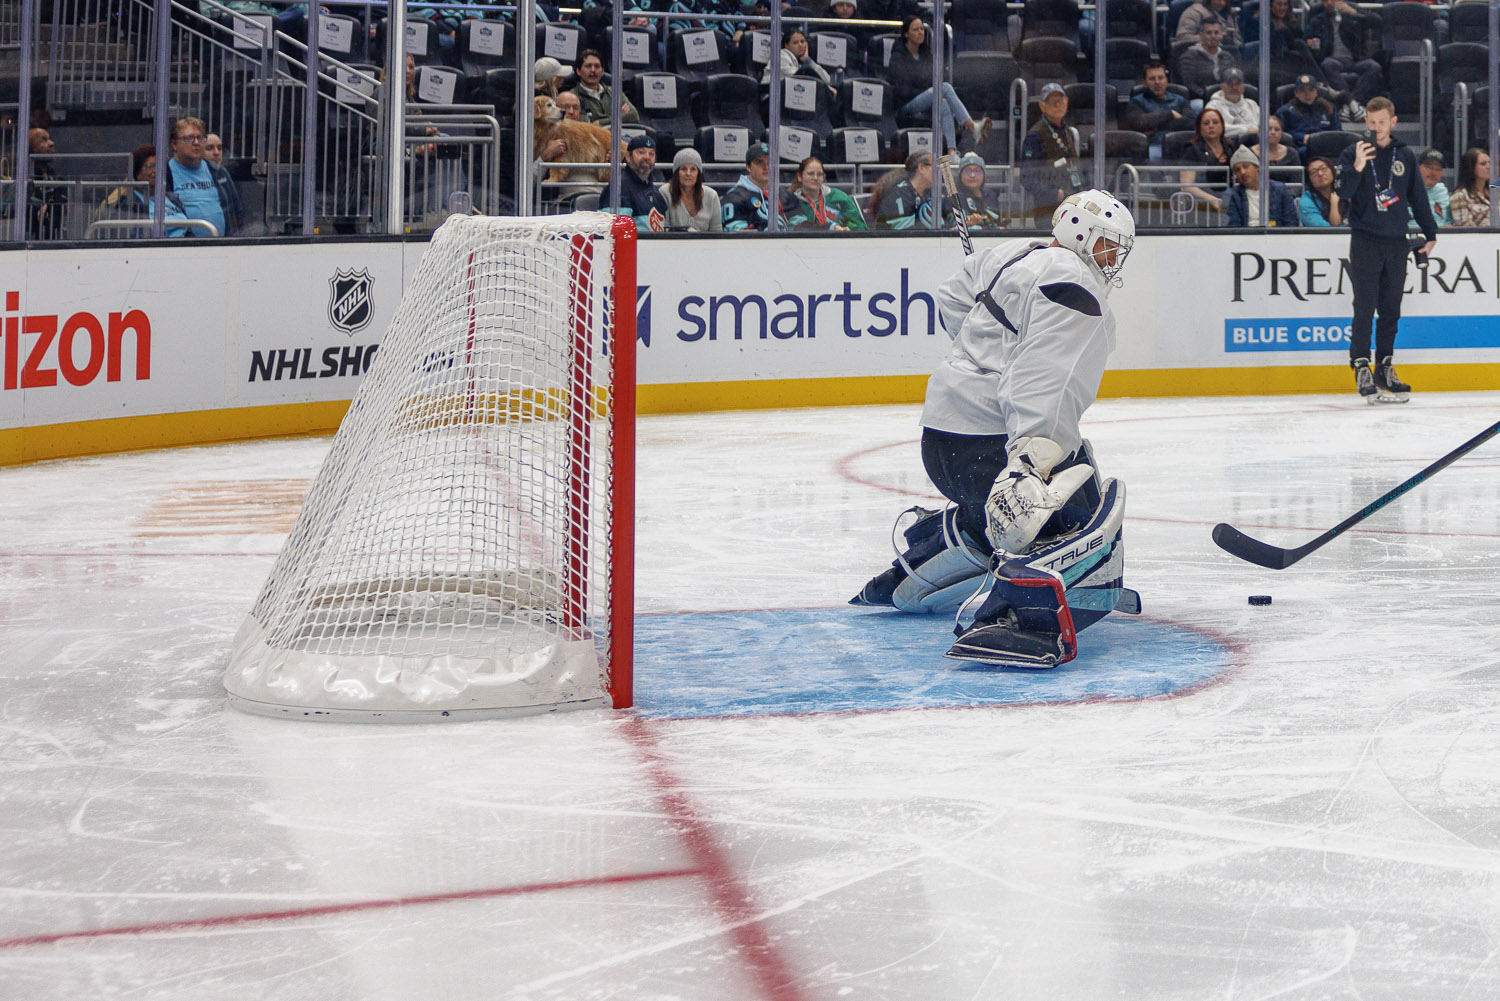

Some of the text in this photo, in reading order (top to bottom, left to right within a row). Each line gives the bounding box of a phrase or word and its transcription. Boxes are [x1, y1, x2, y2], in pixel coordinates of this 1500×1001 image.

[1231, 252, 1486, 302] PRERA
[338, 285, 367, 321] NHL
[676, 268, 945, 342] smartsh
[0, 290, 152, 391] izon
[1232, 325, 1354, 344] BLUE CROS
[1043, 534, 1104, 570] TRUE
